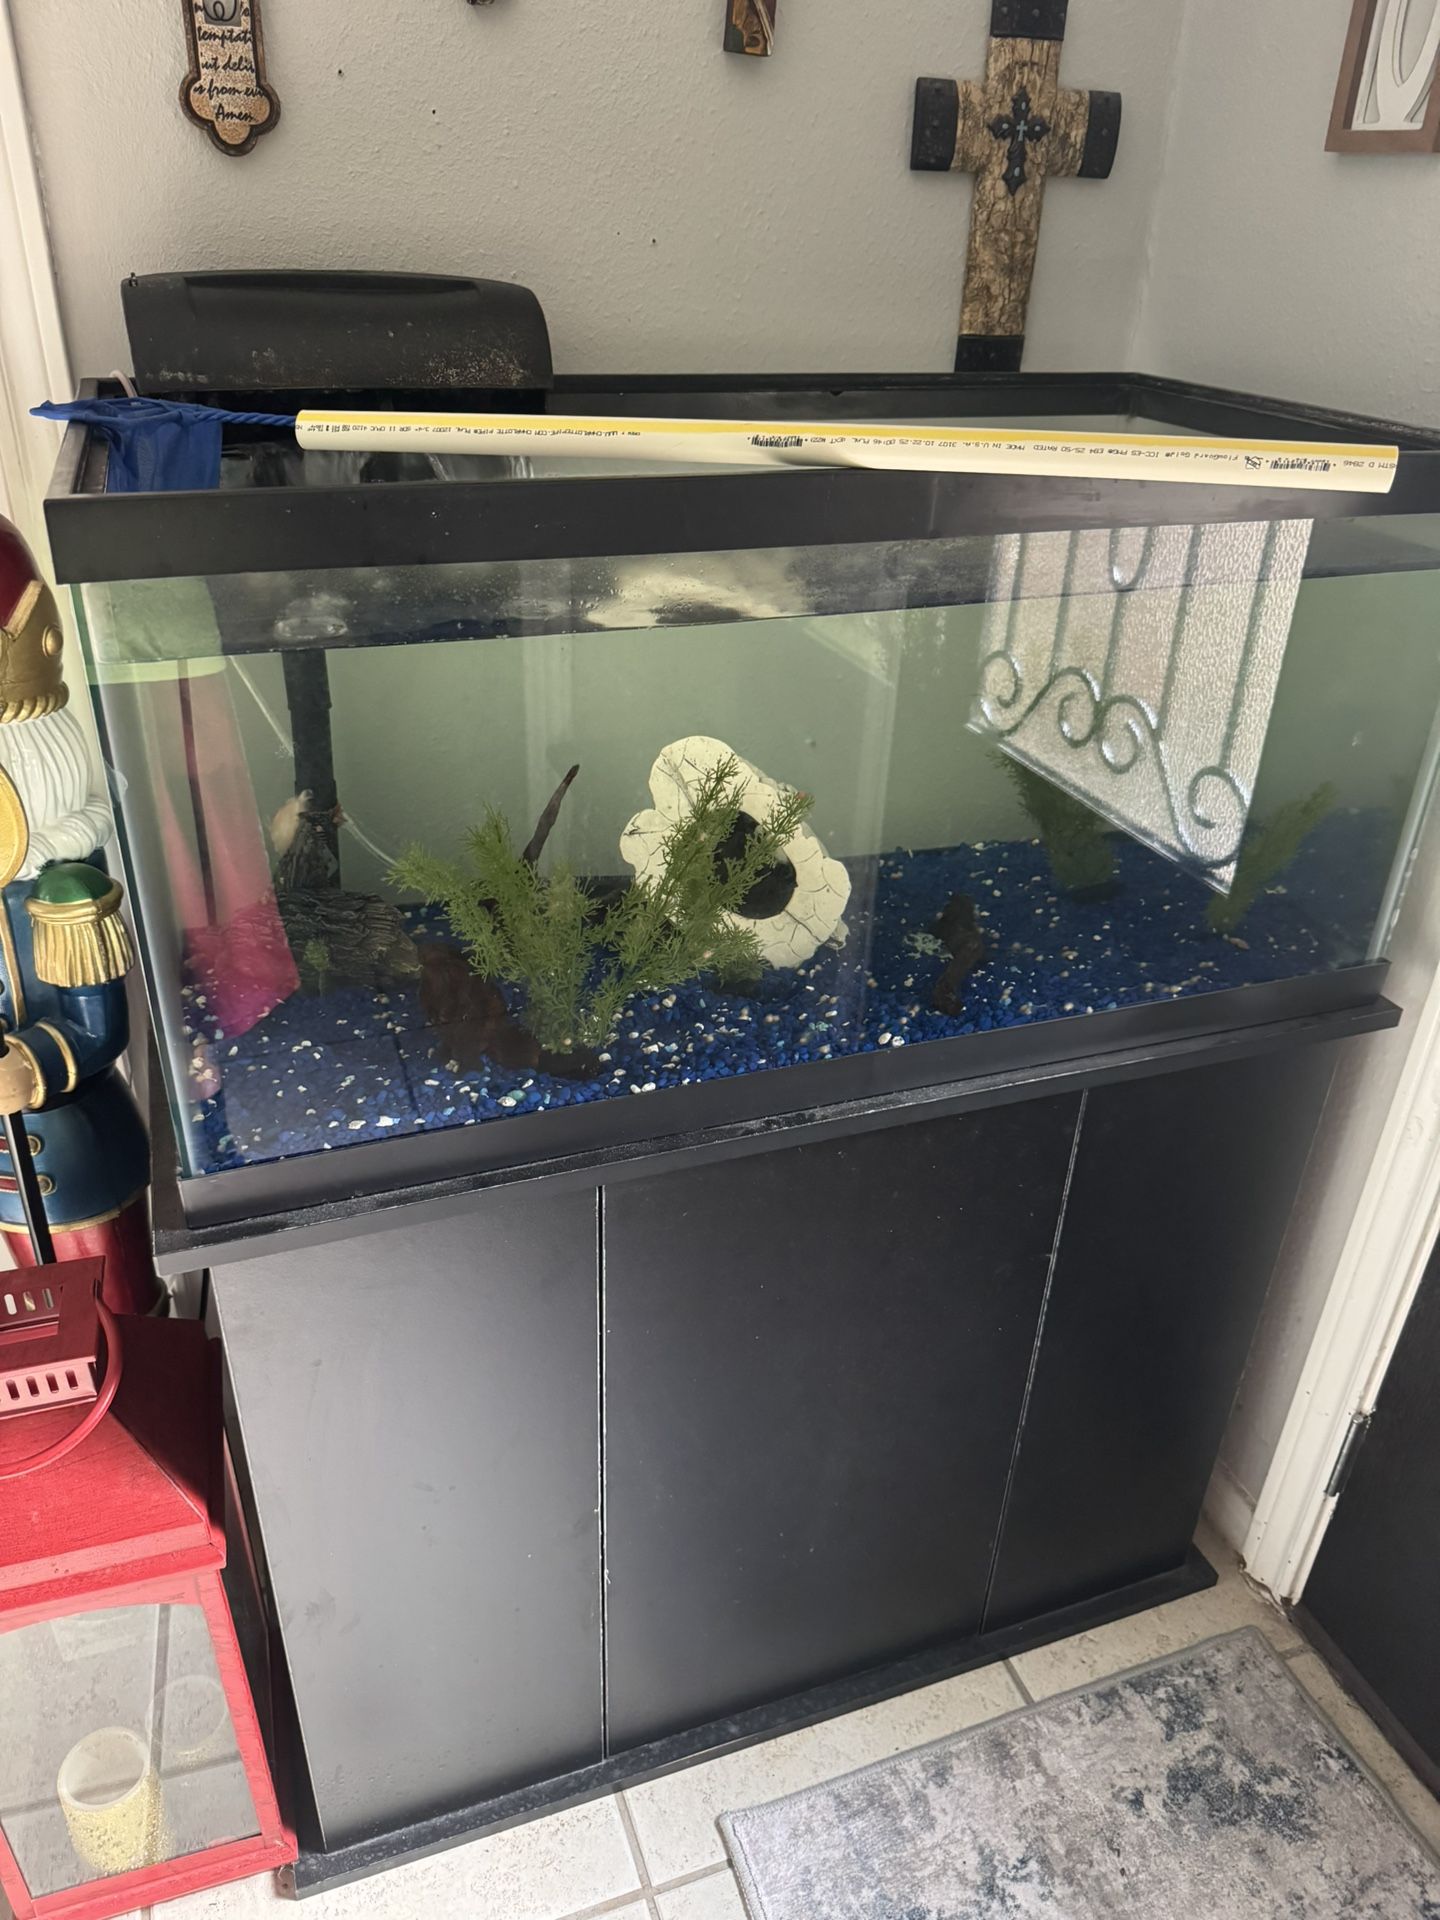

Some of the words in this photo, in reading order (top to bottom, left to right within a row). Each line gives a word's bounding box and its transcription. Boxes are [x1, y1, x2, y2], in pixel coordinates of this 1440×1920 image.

[208, 78, 242, 100] from
[496, 428, 532, 436] CHARLOTTE
[962, 441, 989, 449] U.S.A.
[1006, 443, 1026, 451] MADE
[1033, 444, 1058, 452] RATED
